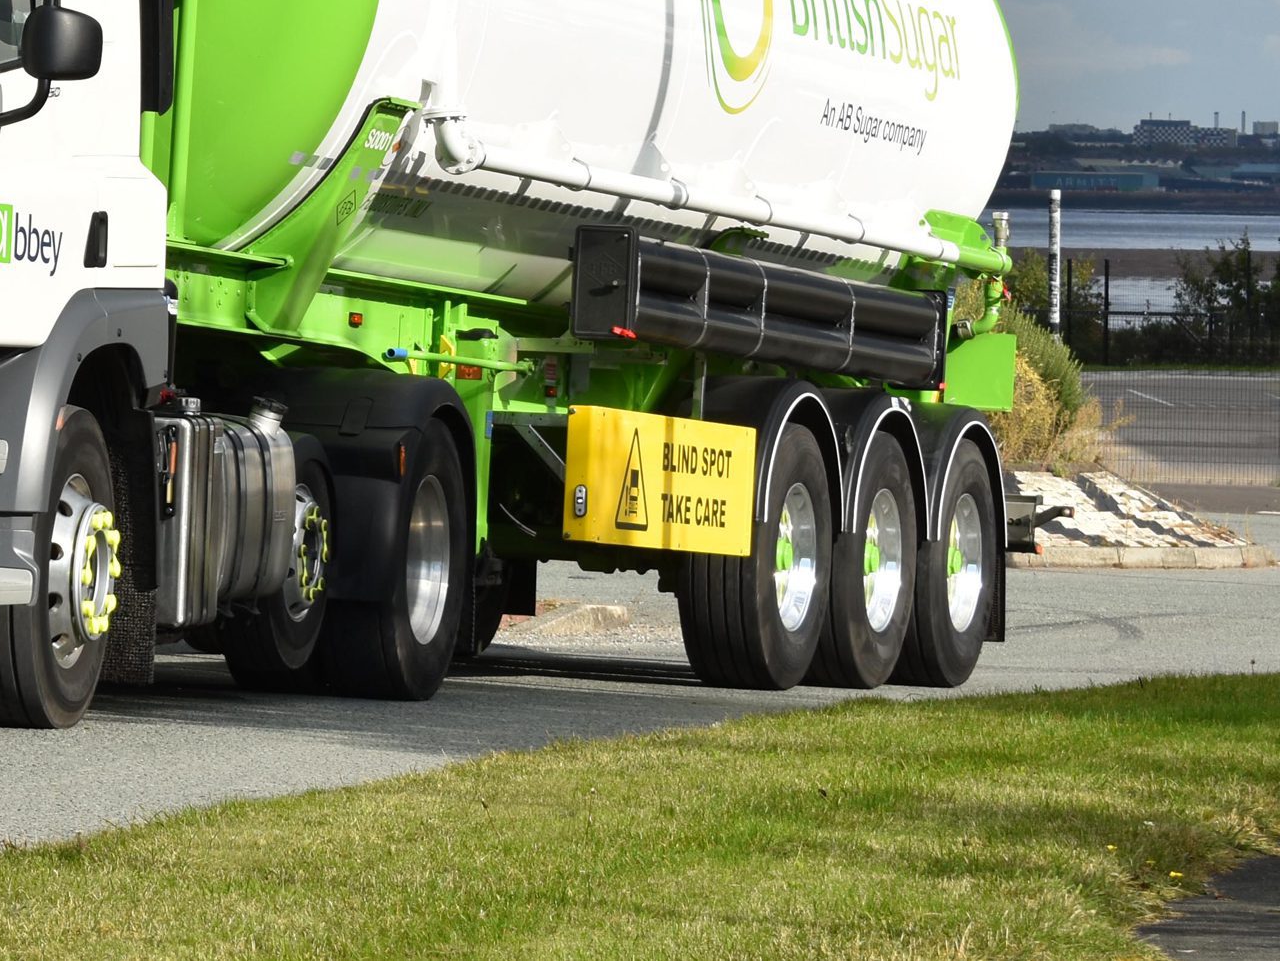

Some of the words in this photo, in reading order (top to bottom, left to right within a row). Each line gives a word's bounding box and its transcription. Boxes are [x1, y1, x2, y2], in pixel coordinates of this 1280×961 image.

[820, 98, 836, 127] An
[836, 102, 853, 131] AB
[853, 105, 882, 144] Sugar
[882, 120, 927, 156] company
[662, 442, 698, 475] BLIND
[701, 447, 732, 479] SPOT
[661, 493, 691, 525] TAKE
[695, 497, 727, 528] CARE
